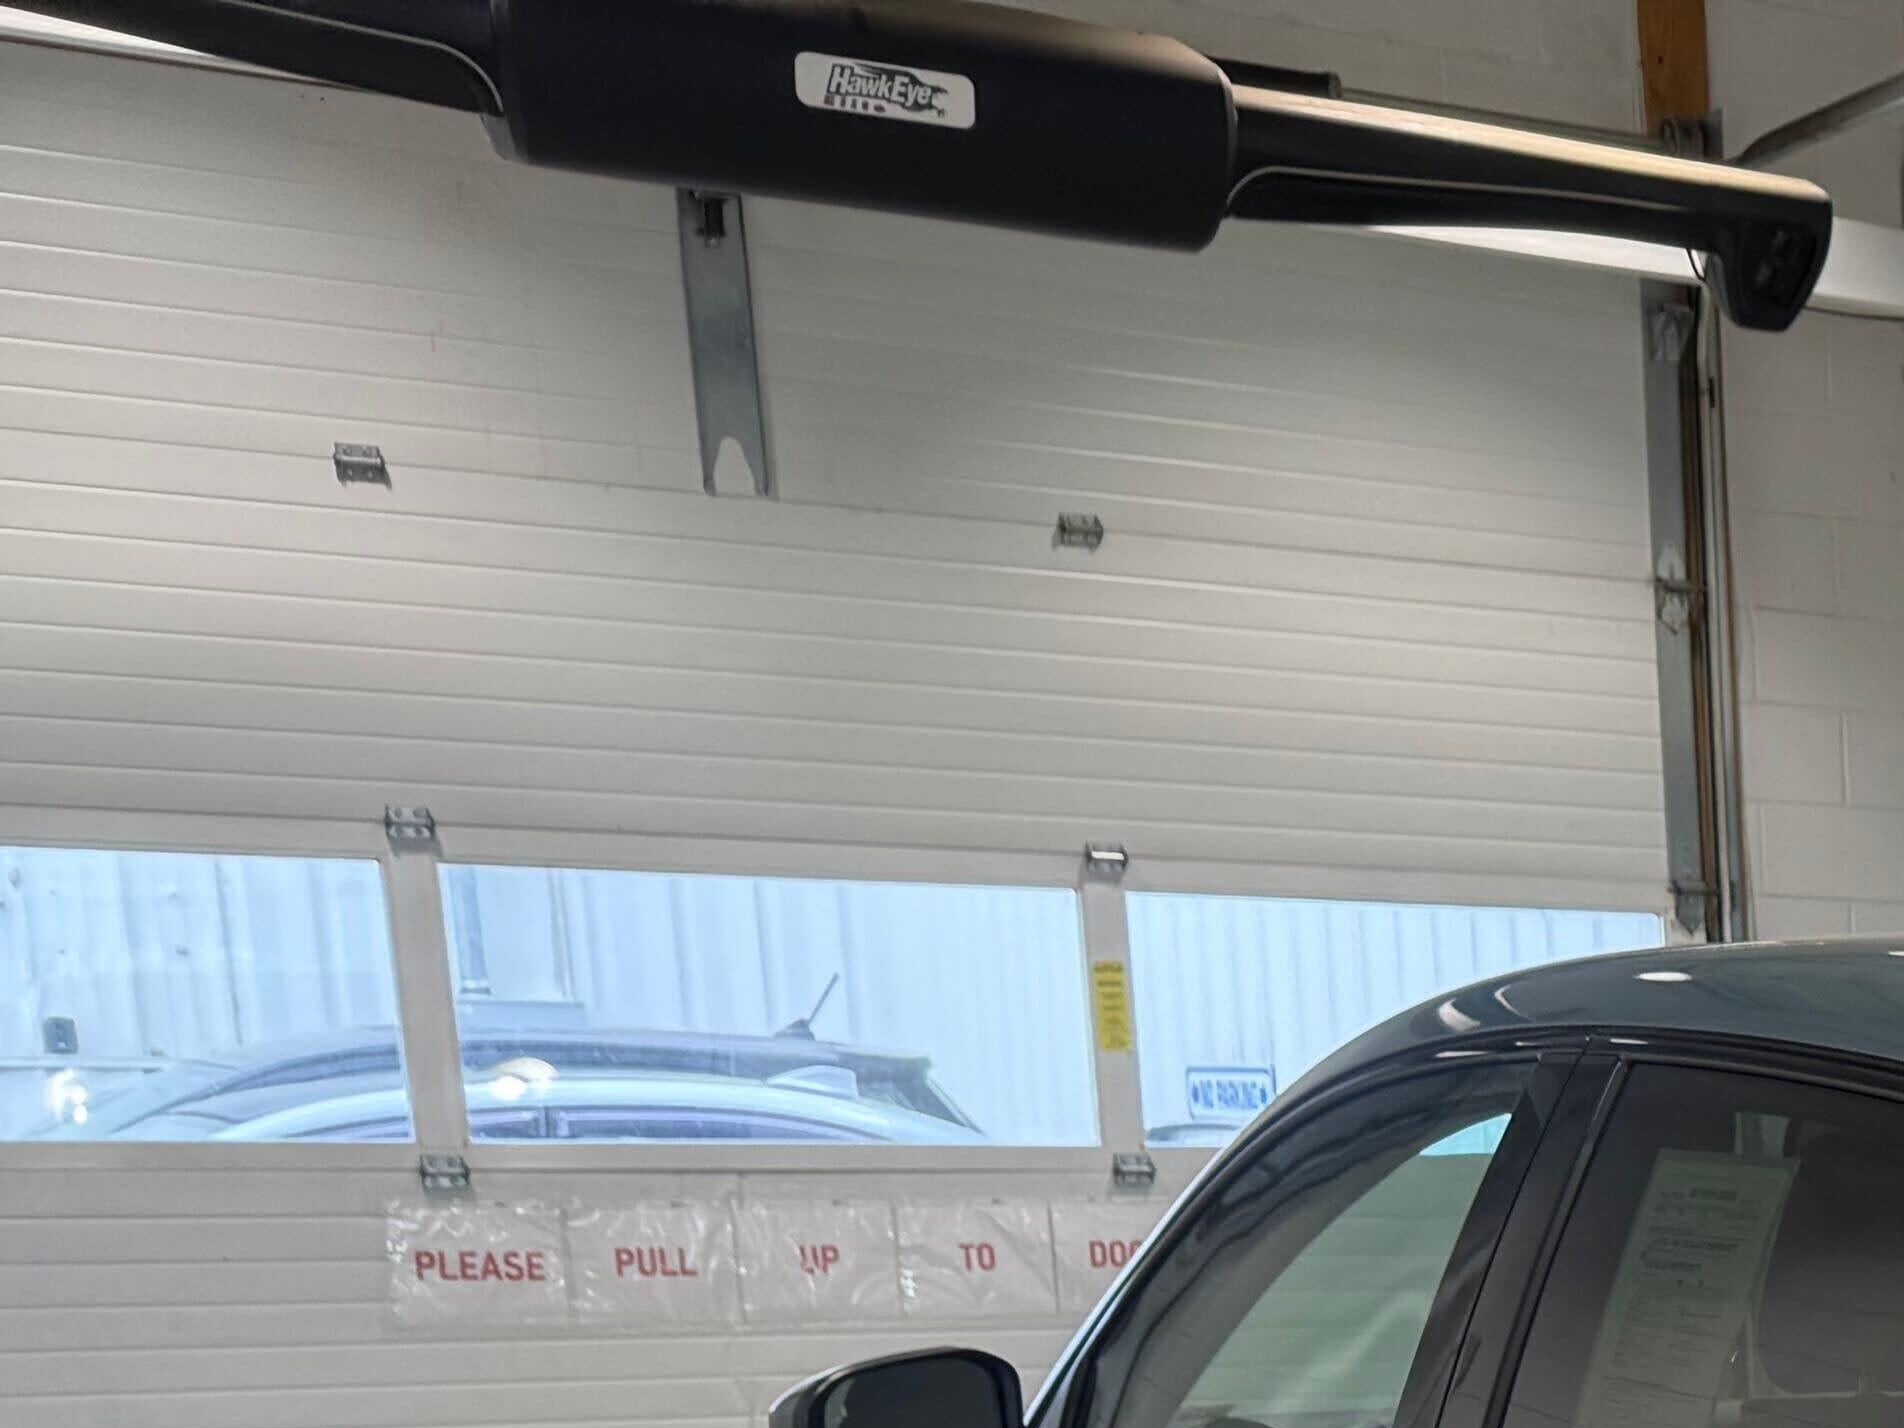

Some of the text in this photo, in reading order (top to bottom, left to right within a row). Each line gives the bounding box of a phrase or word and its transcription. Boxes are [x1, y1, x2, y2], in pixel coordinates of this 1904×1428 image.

[828, 64, 933, 107] HawkEye
[415, 1250, 546, 1281] PLEASE
[614, 1247, 698, 1277] PULL
[799, 1244, 839, 1274] UP
[959, 1242, 996, 1271] TO
